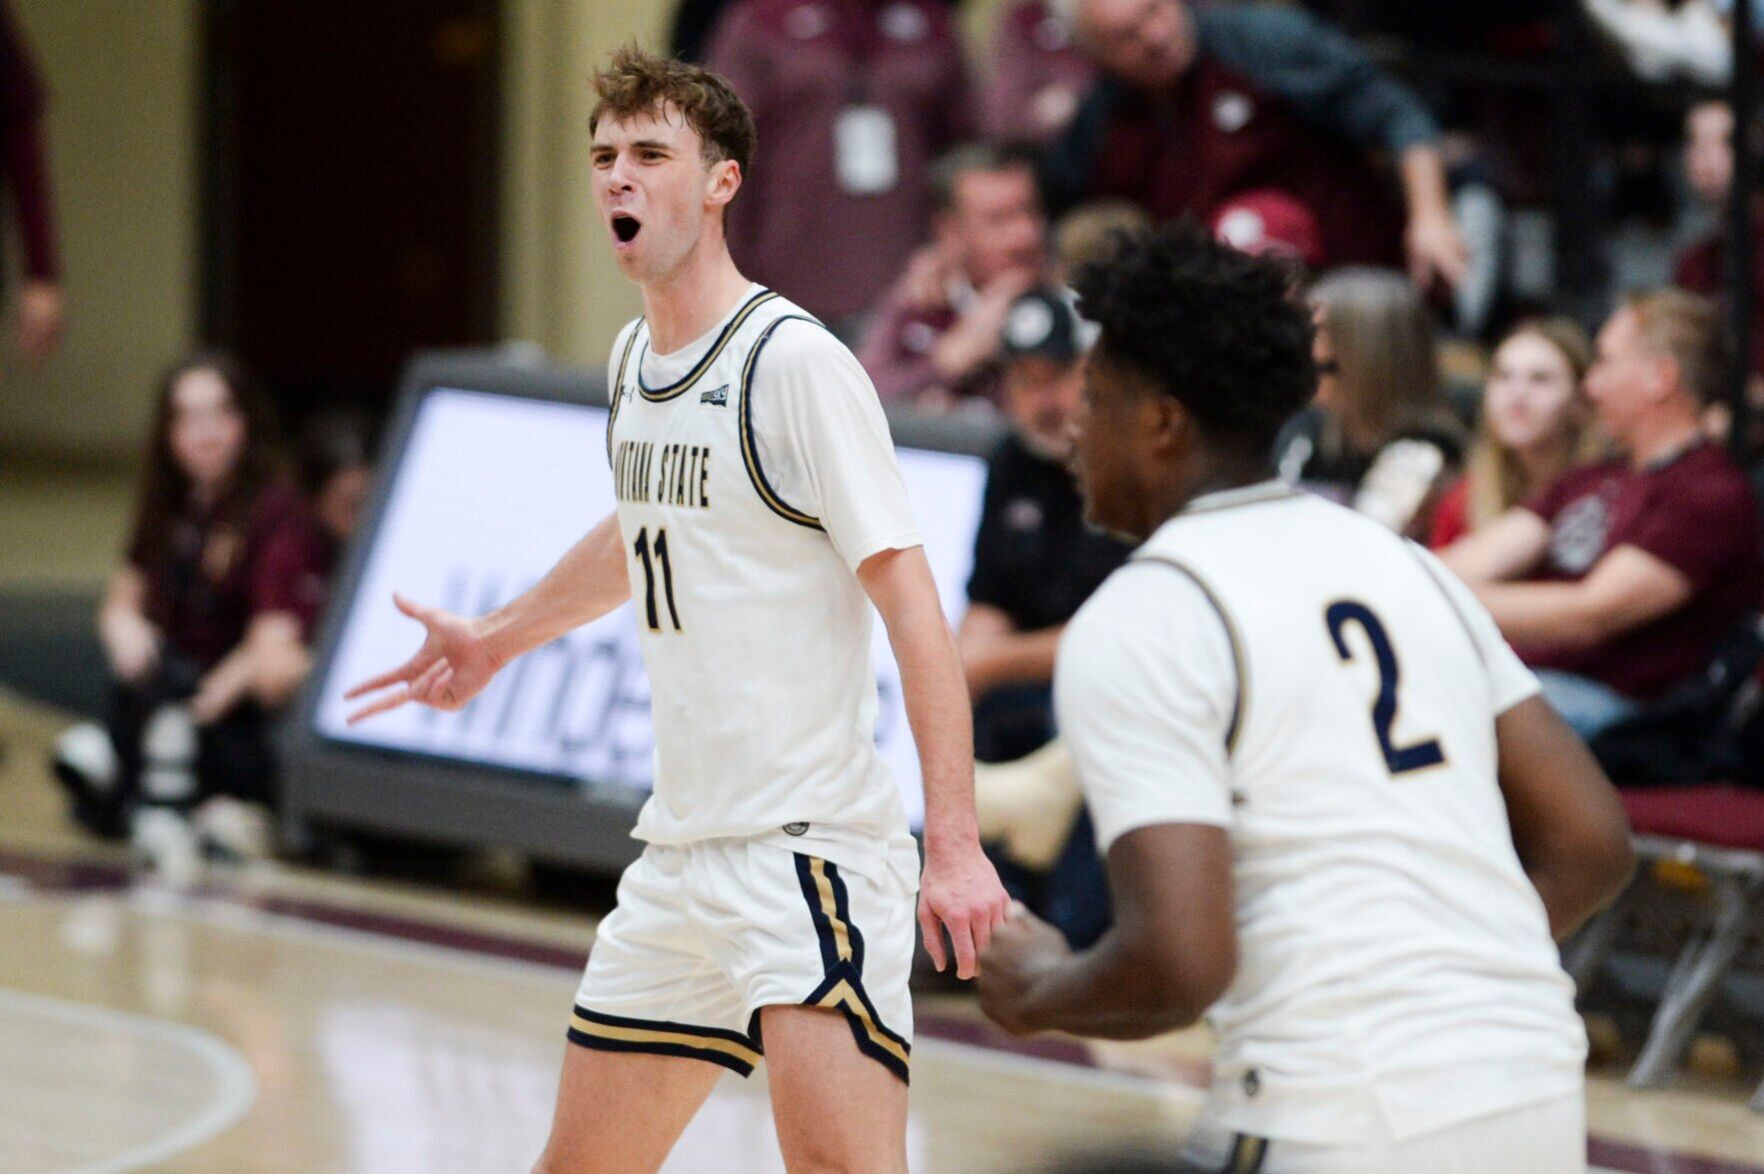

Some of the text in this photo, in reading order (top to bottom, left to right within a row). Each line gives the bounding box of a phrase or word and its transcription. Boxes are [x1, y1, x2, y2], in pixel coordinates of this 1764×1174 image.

[657, 443, 711, 508] STATE
[633, 526, 684, 634] 11
[1323, 597, 1448, 776] 2
